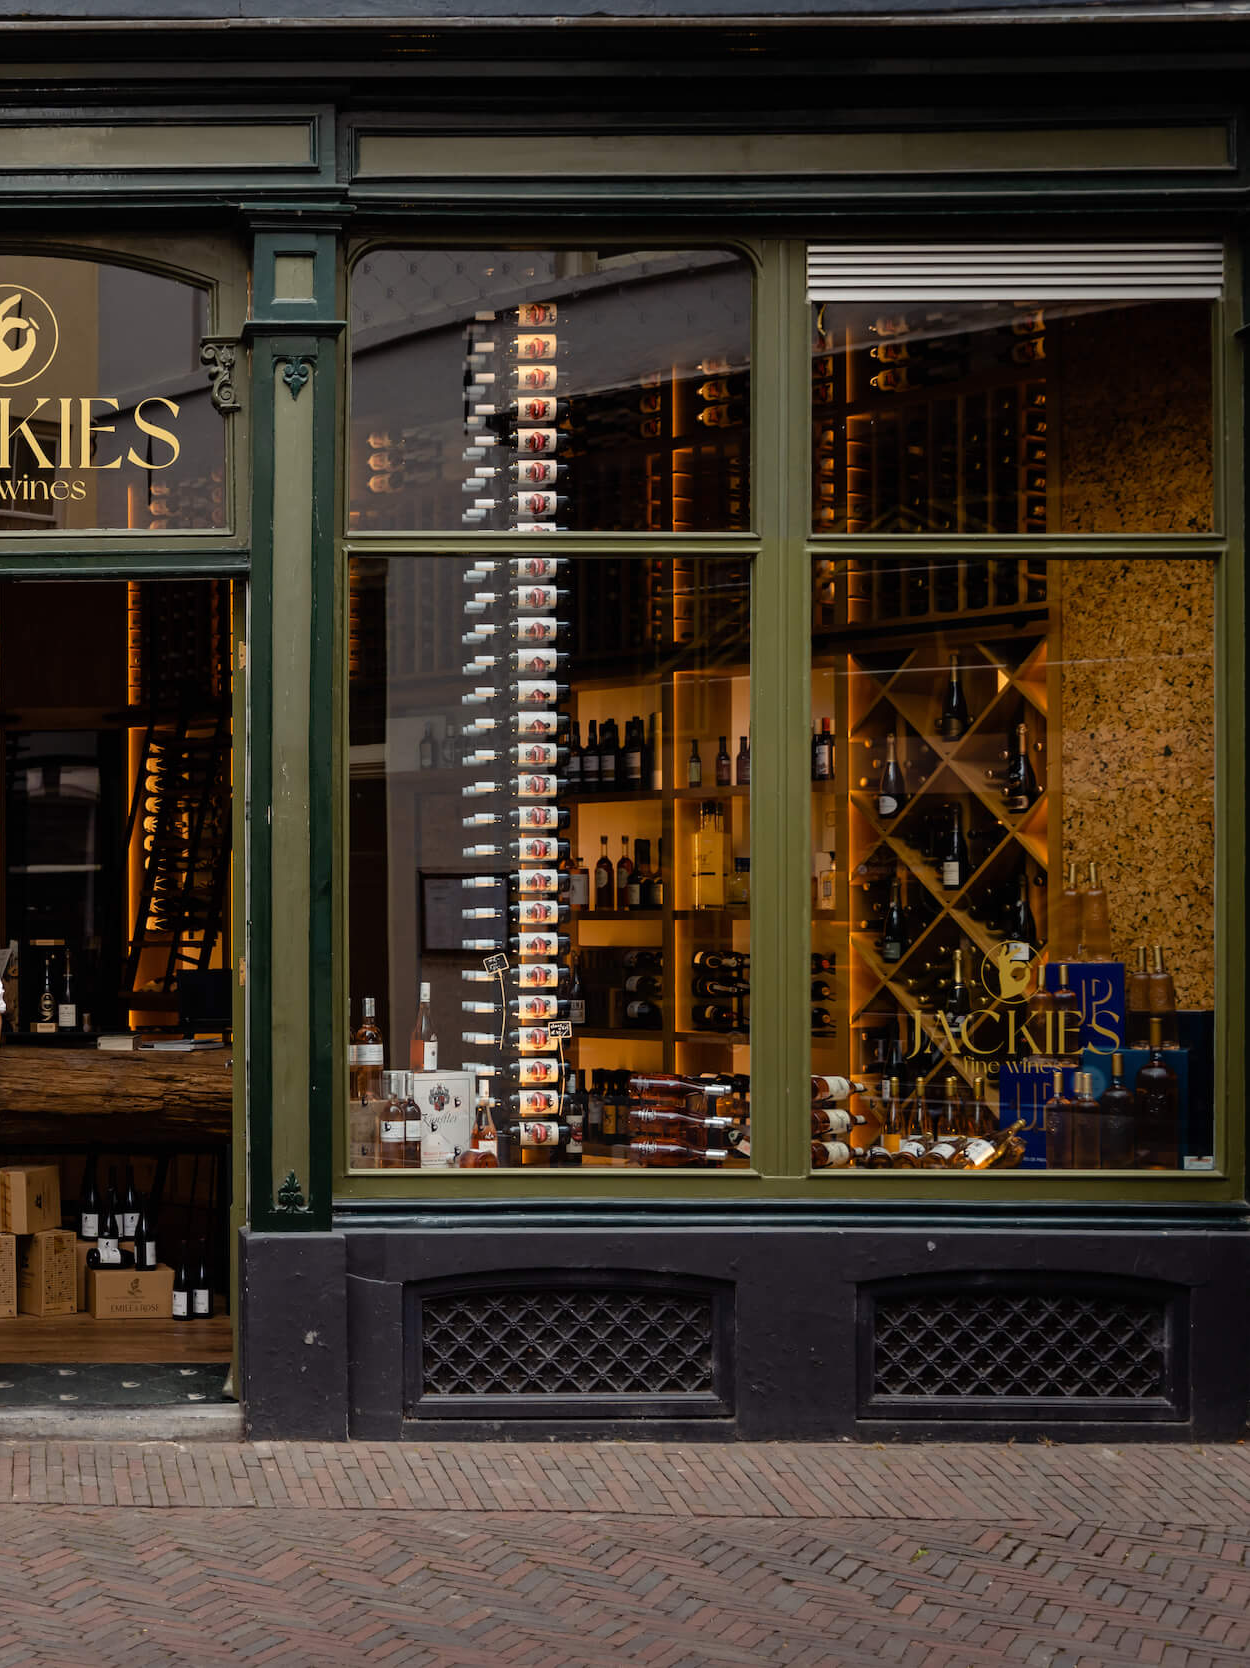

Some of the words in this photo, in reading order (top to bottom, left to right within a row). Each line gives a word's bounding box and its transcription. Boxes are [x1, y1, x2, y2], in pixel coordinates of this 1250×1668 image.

[907, 1009, 1120, 1059] JACKIES
[963, 1055, 1000, 1074] fine
[1006, 1057, 1063, 1074] wines
